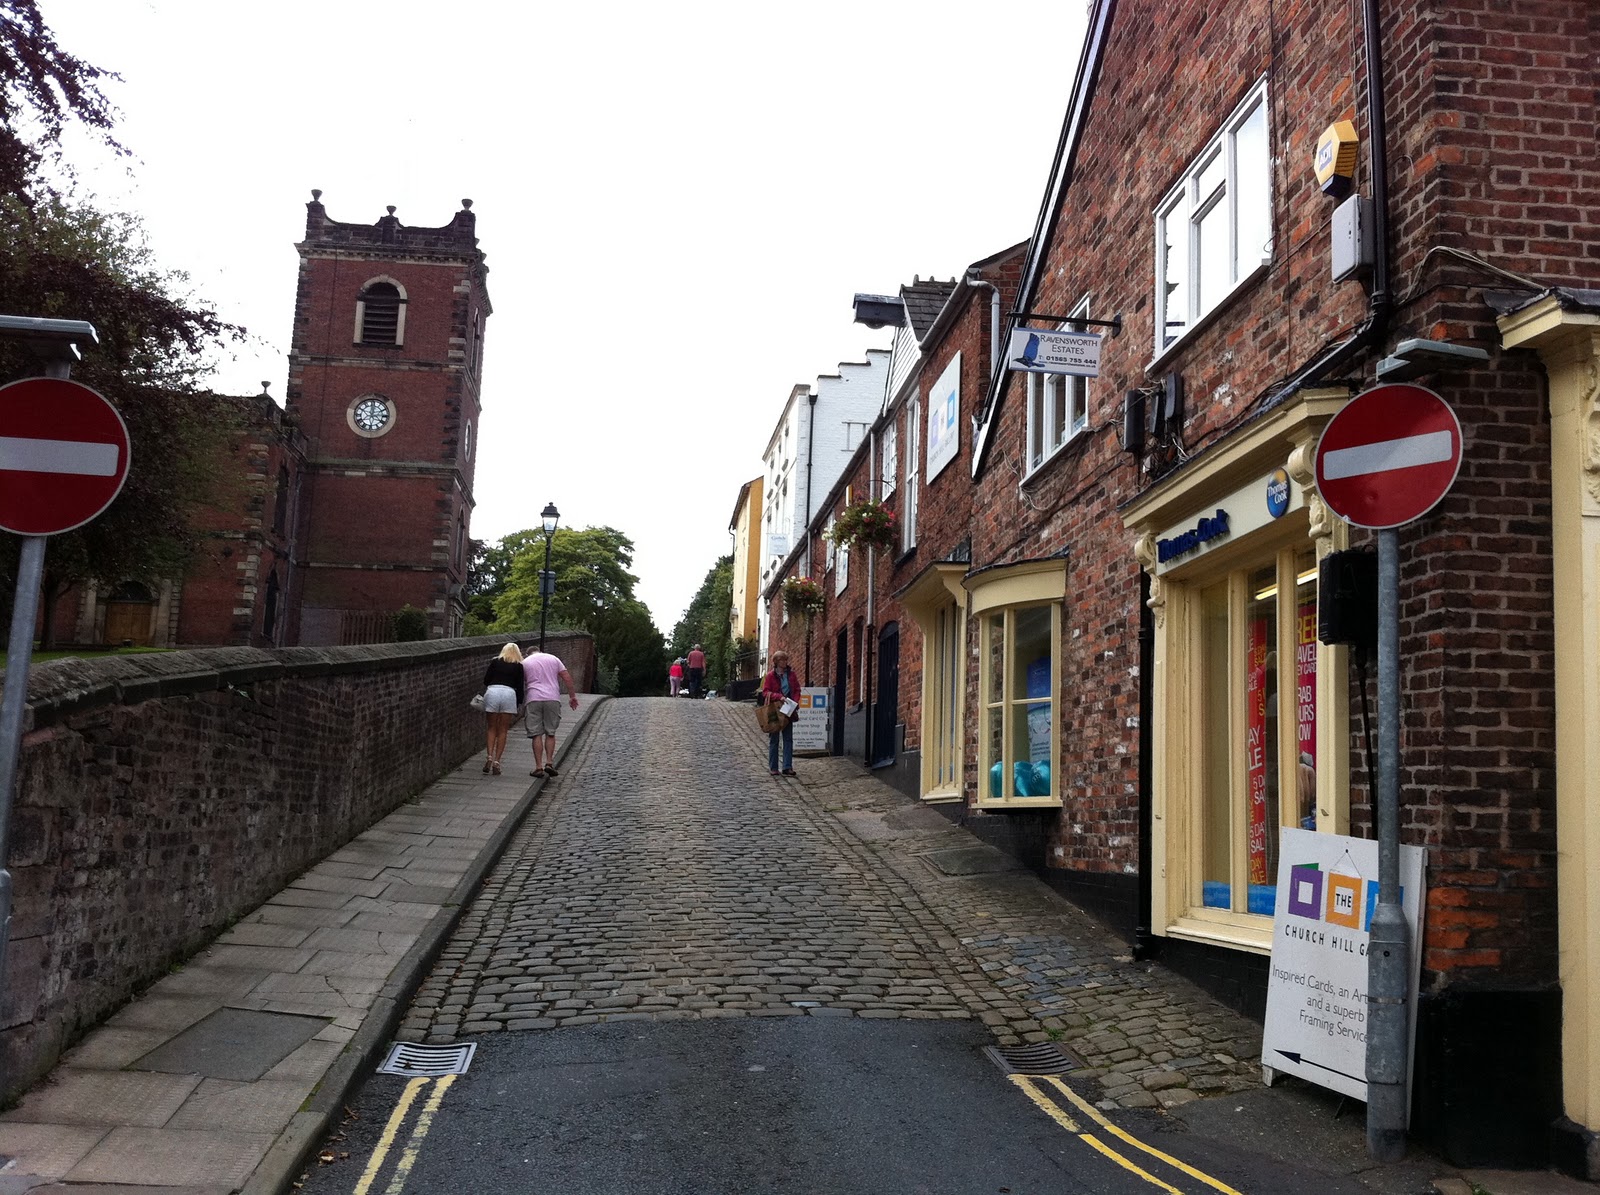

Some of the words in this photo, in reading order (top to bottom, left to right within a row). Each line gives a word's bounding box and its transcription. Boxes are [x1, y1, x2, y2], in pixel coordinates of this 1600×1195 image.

[1040, 334, 1098, 347] RAVENSWORTH
[1051, 344, 1085, 355] ESTATES
[1267, 480, 1288, 498] Thomas
[1274, 490, 1288, 504] Cook
[1297, 613, 1317, 644] REE
[1297, 643, 1317, 663] AVEL
[1298, 703, 1315, 722] URS
[1248, 724, 1261, 748] AY
[1298, 723, 1312, 741] OW
[1248, 746, 1263, 772] LE
[1335, 893, 1352, 908] THE
[1285, 924, 1325, 945] CHURCH
[1331, 935, 1354, 953] HILL
[1272, 964, 1306, 985] Inspired
[1307, 975, 1336, 996] Cards,
[1338, 987, 1349, 999] an
[1306, 996, 1323, 1010] and
[1325, 1003, 1331, 1012] a
[1333, 1004, 1365, 1022] superb
[1300, 1009, 1334, 1036] Framing
